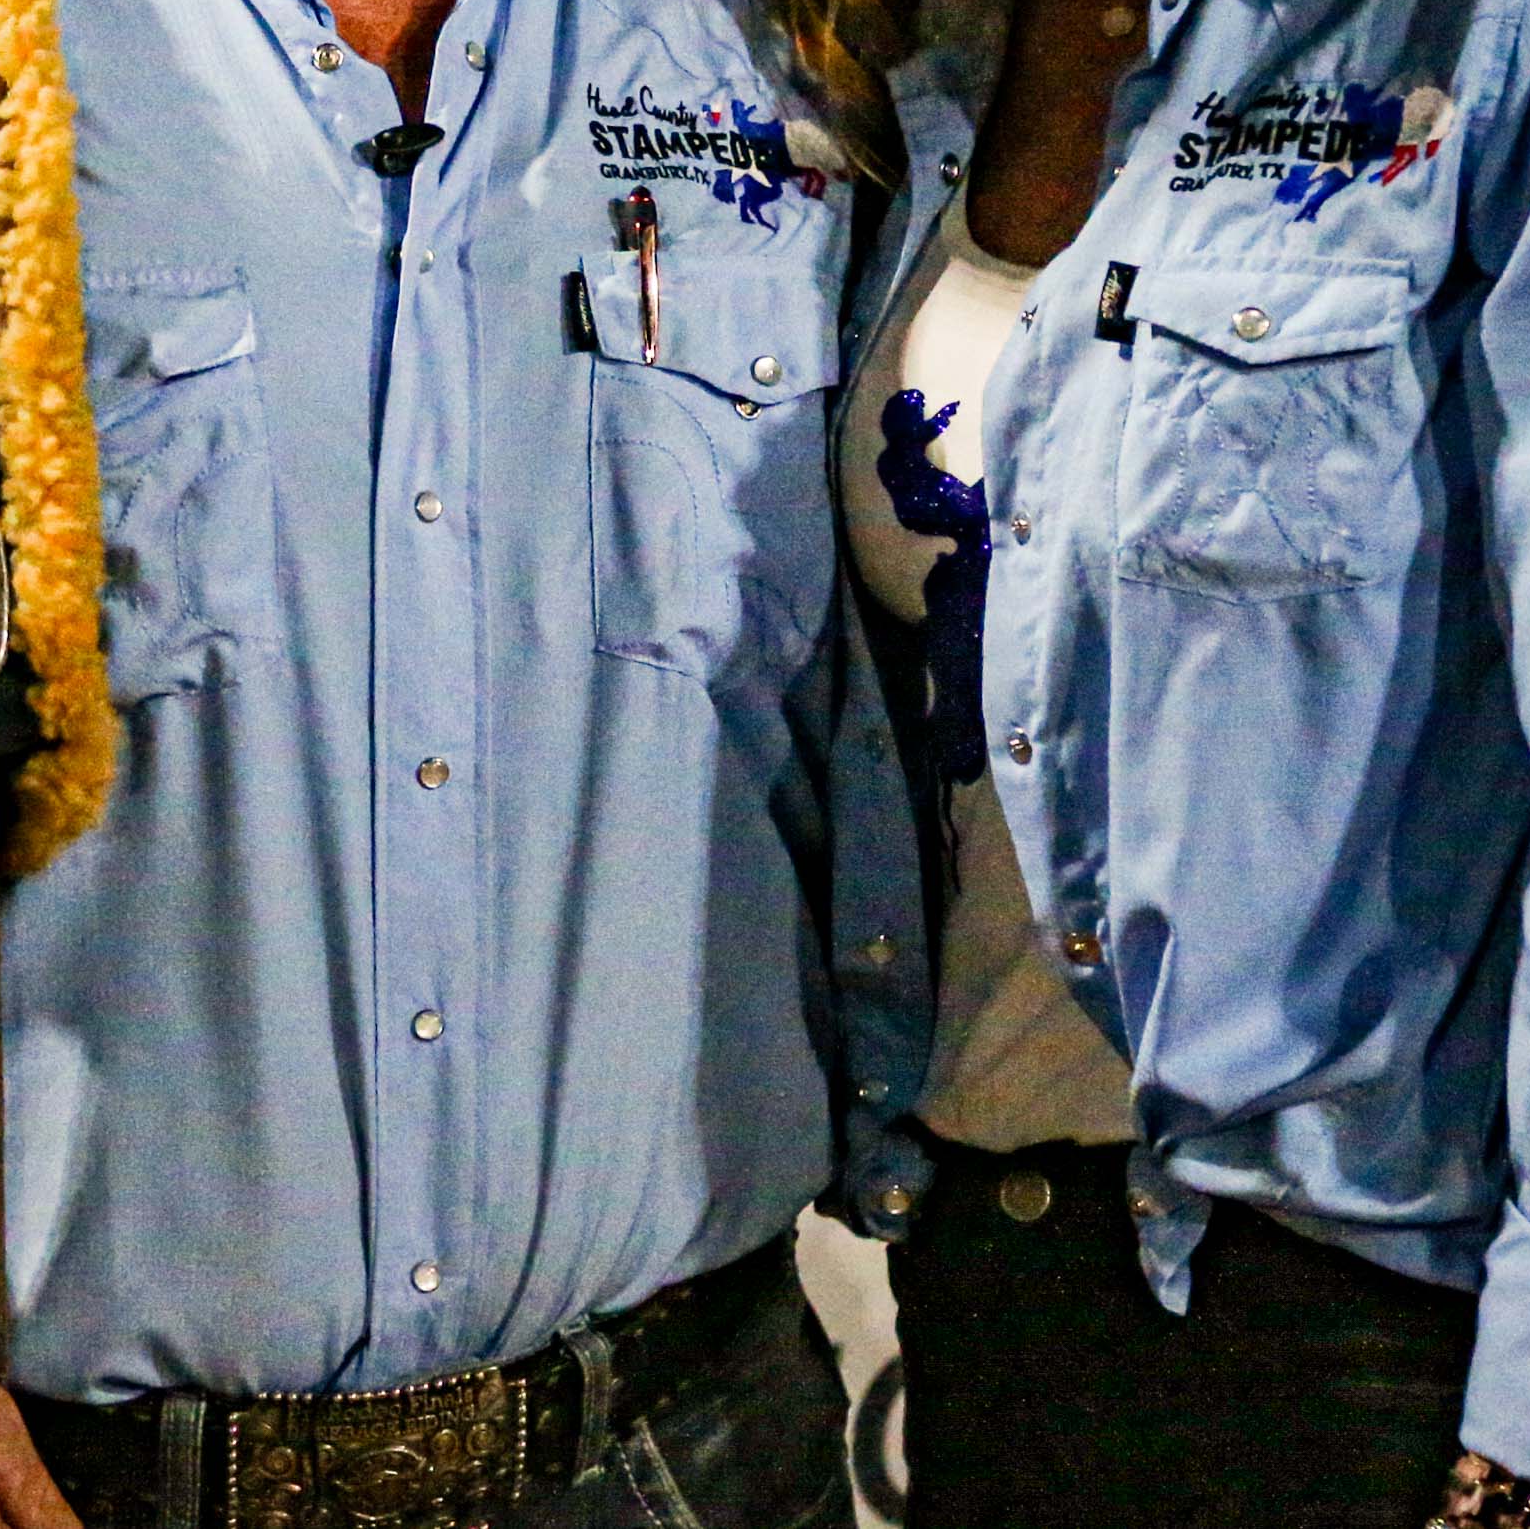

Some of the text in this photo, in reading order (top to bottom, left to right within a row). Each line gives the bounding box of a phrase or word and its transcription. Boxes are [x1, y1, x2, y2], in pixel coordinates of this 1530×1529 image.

[587, 82, 700, 133] Hood County
[1258, 162, 1286, 180] TX
